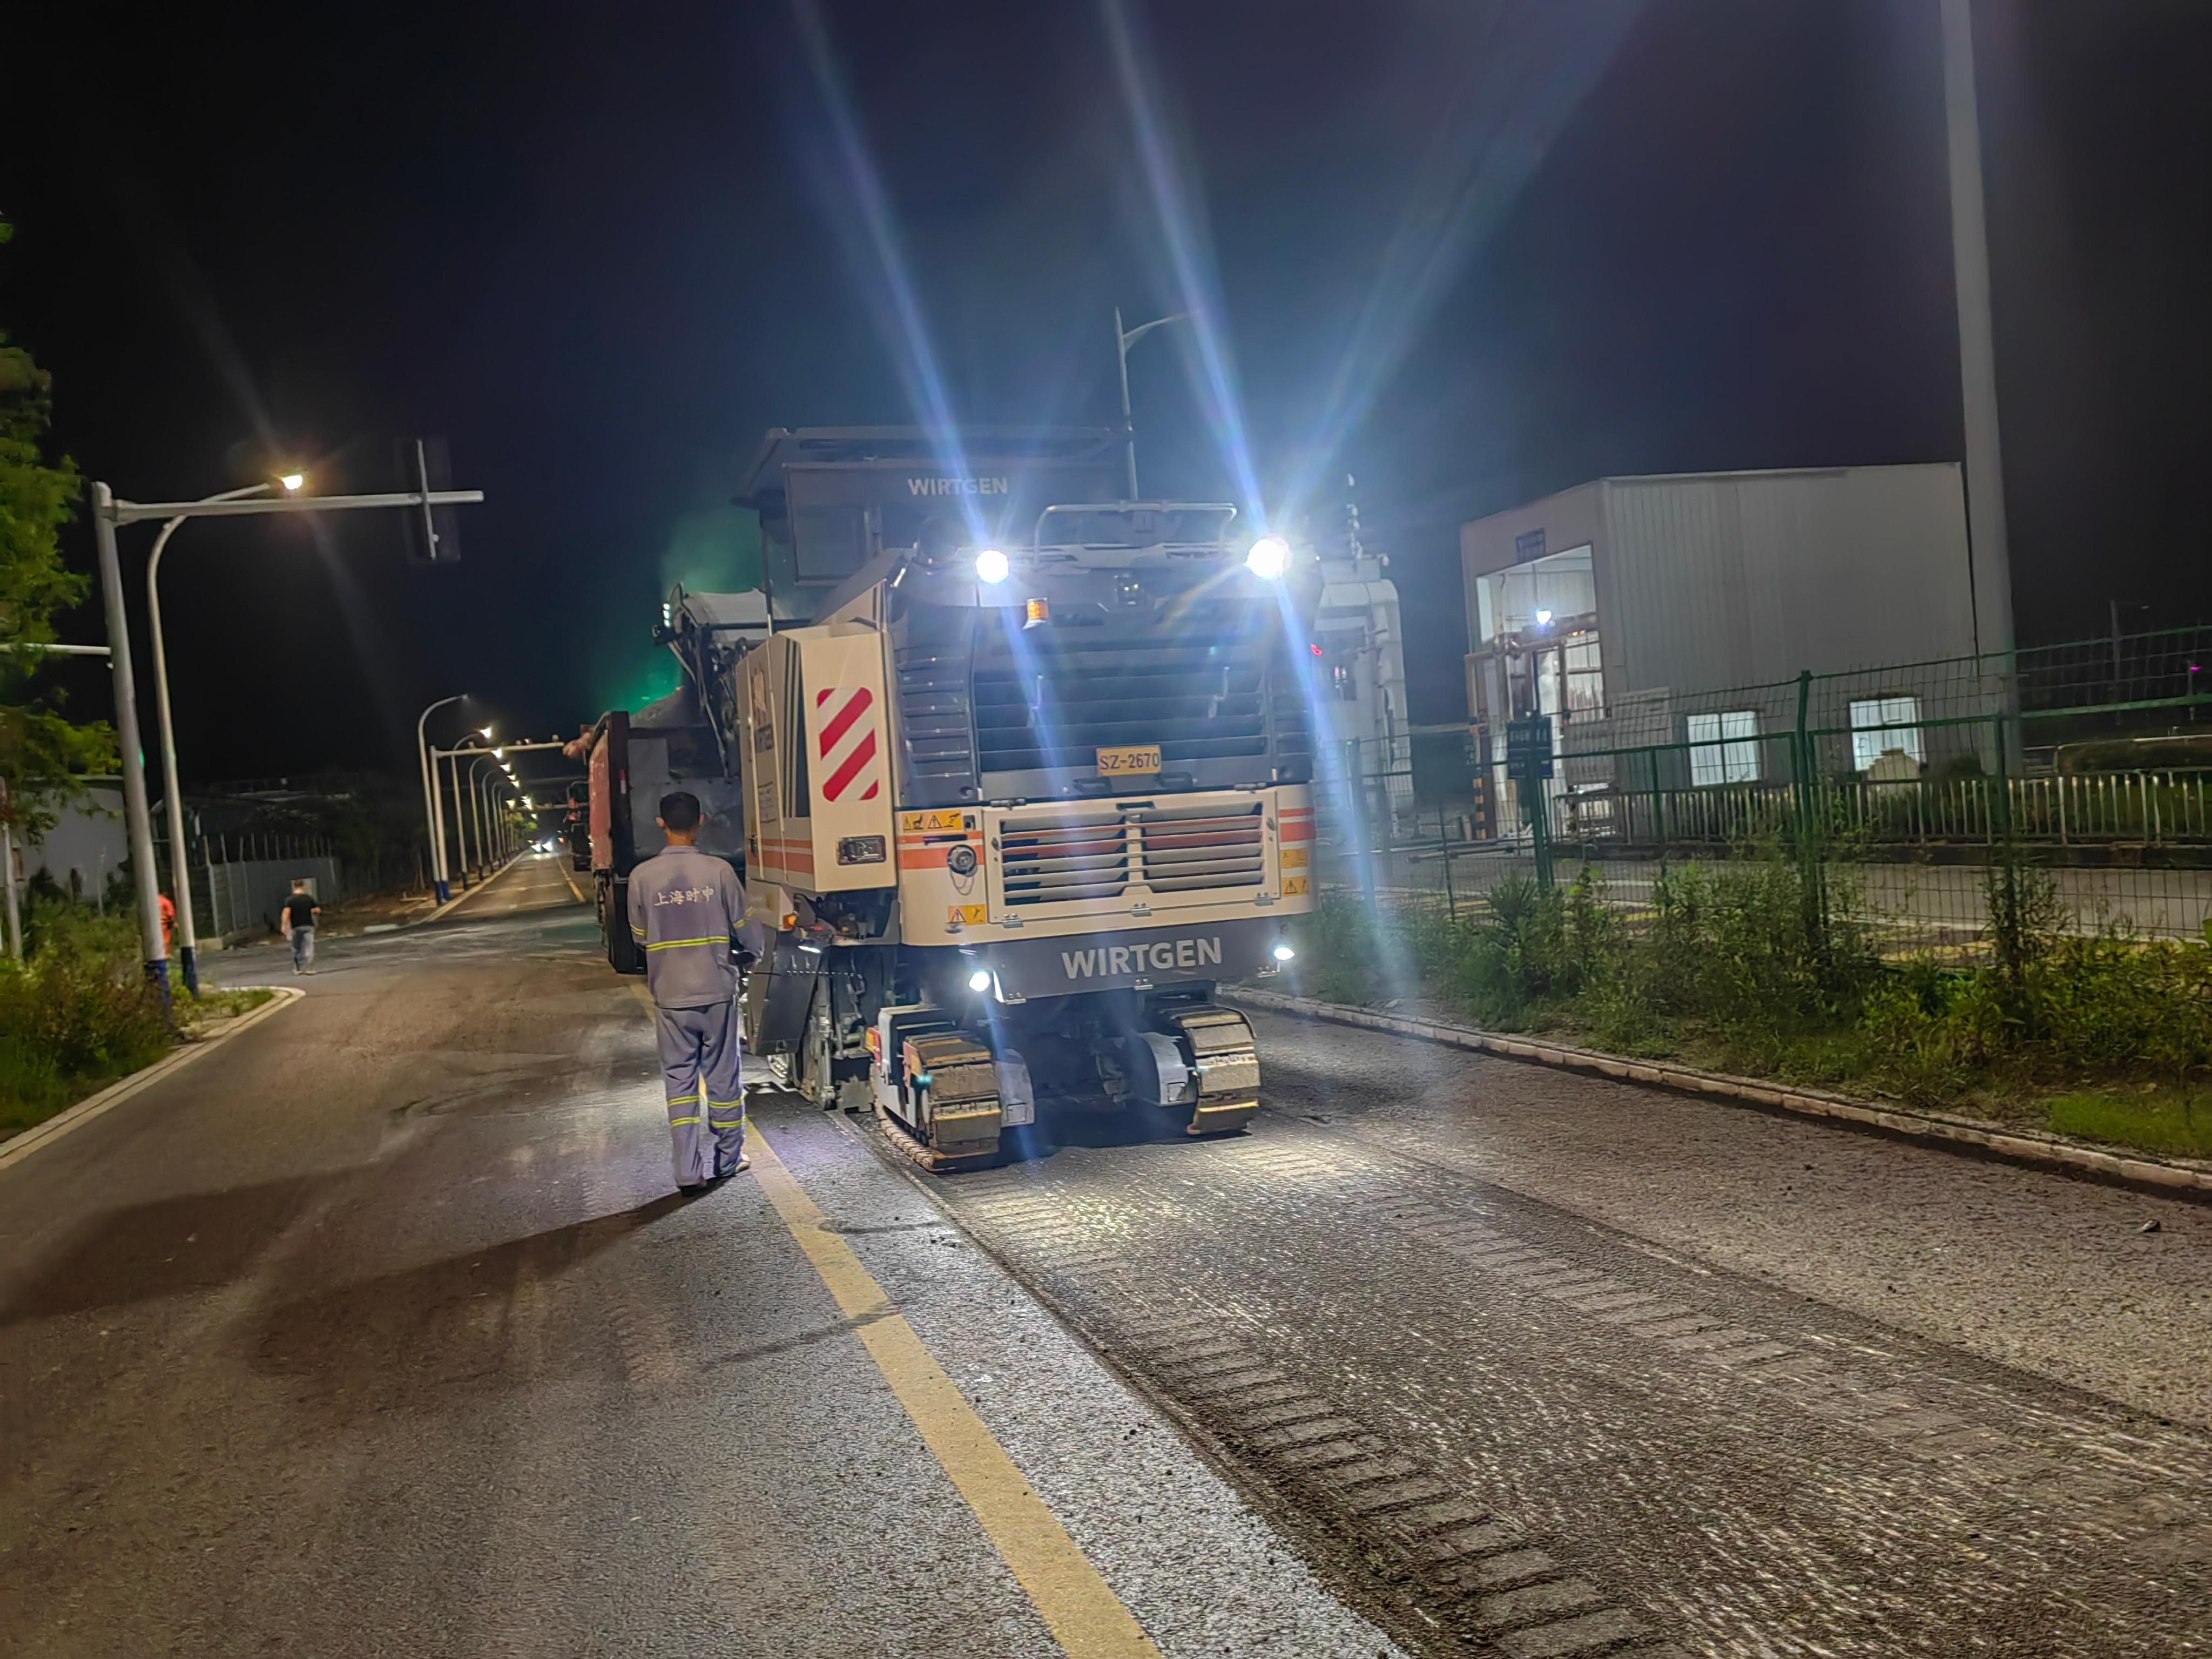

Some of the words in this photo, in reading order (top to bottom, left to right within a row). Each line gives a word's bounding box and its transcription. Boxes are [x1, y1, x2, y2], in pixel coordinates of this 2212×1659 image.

[908, 477, 1008, 496] WIRTGEN
[1100, 753, 1160, 770] SZ-2670
[1061, 937, 1222, 979] WIRTGEN
